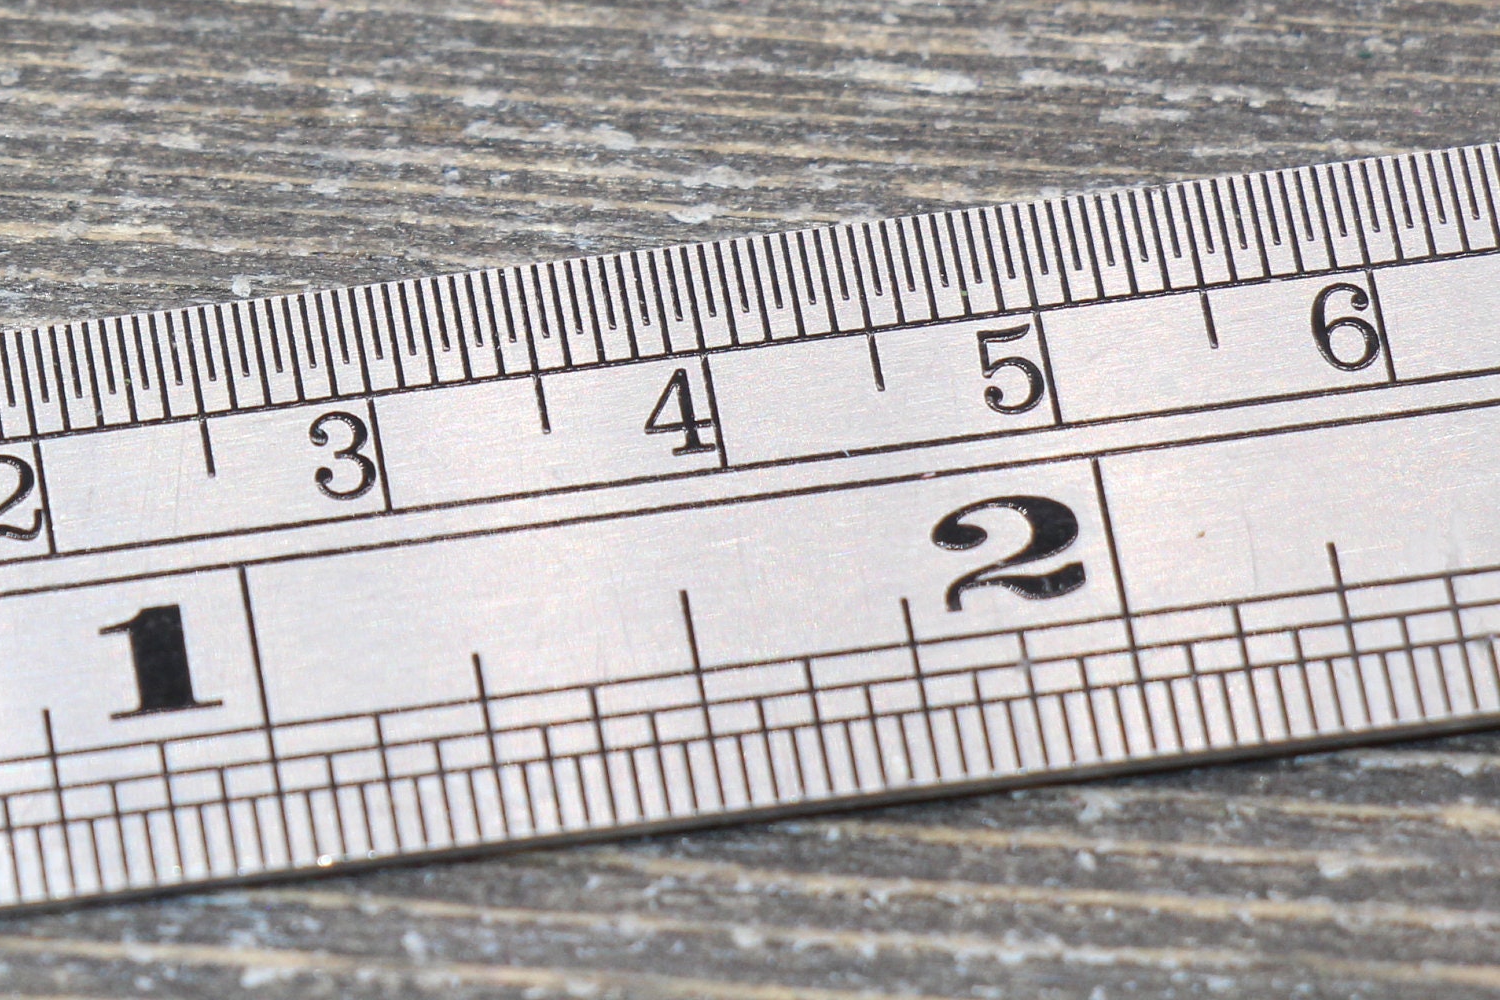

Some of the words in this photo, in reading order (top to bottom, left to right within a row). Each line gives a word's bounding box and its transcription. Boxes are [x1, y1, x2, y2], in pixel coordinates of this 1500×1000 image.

[308, 410, 378, 500] 3
[644, 368, 716, 457] 4
[976, 322, 1046, 415] 5
[1310, 282, 1381, 372] 6
[99, 603, 224, 720] 1
[931, 495, 1087, 612] 2
